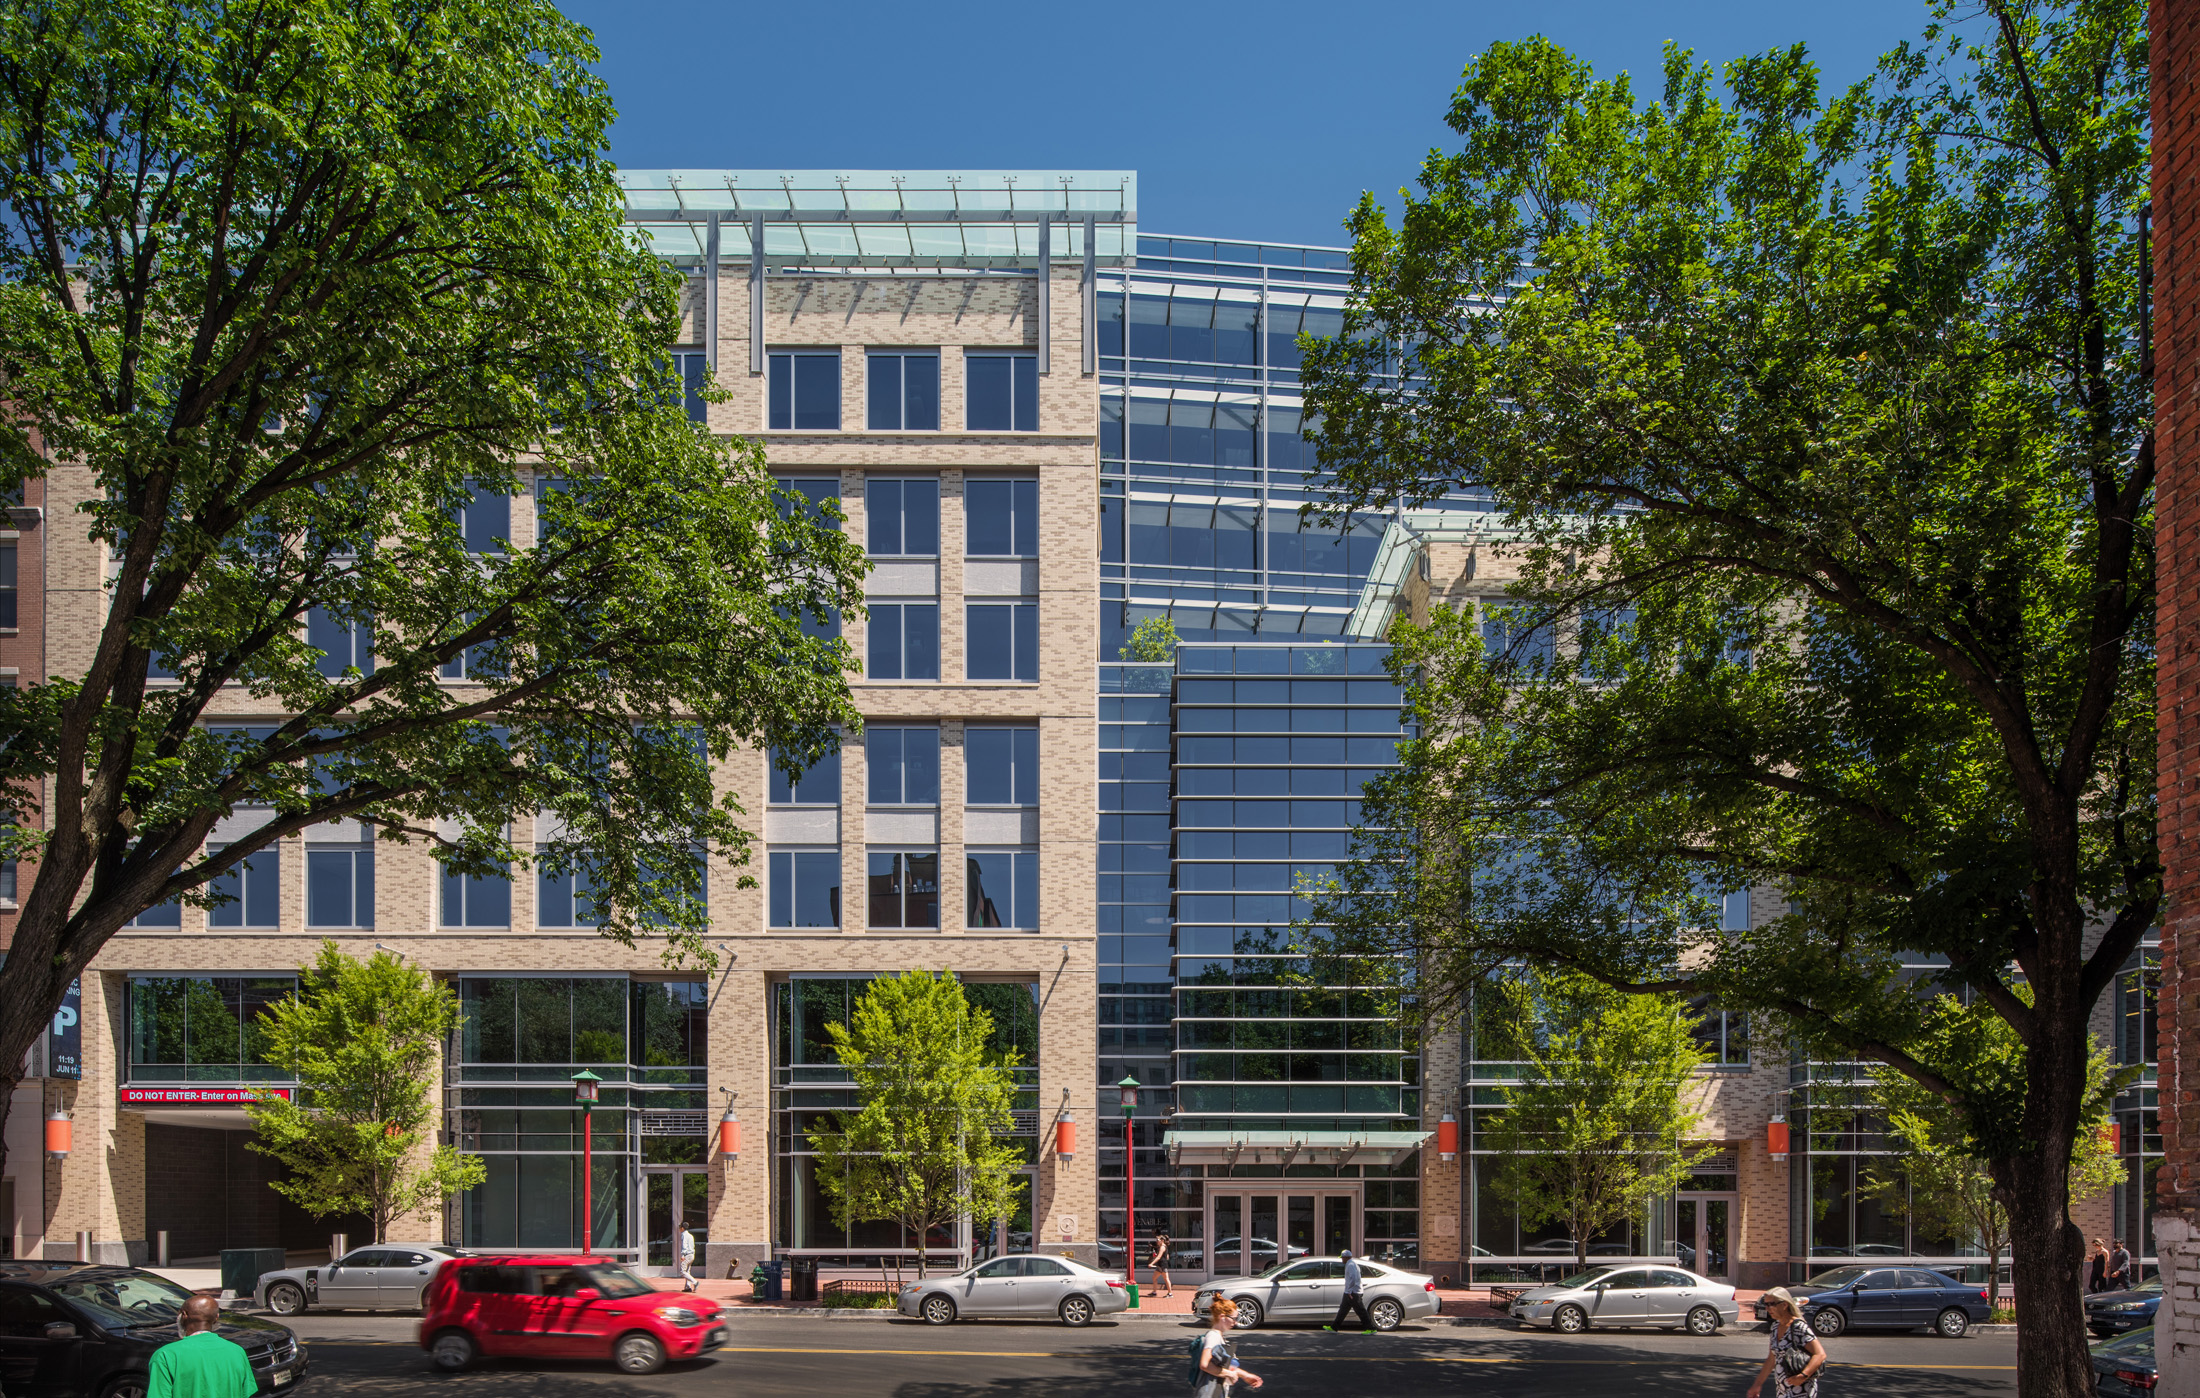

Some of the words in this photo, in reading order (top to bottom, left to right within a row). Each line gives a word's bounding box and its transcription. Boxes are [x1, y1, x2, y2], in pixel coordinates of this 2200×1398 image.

[54, 1005, 77, 1035] P
[58, 1055, 75, 1064] 11:19
[56, 1064, 70, 1074] JUN
[70, 1066, 77, 1074] 11
[129, 1091, 143, 1100] DO
[145, 1091, 164, 1100] NOT
[201, 1091, 225, 1100] Enter
